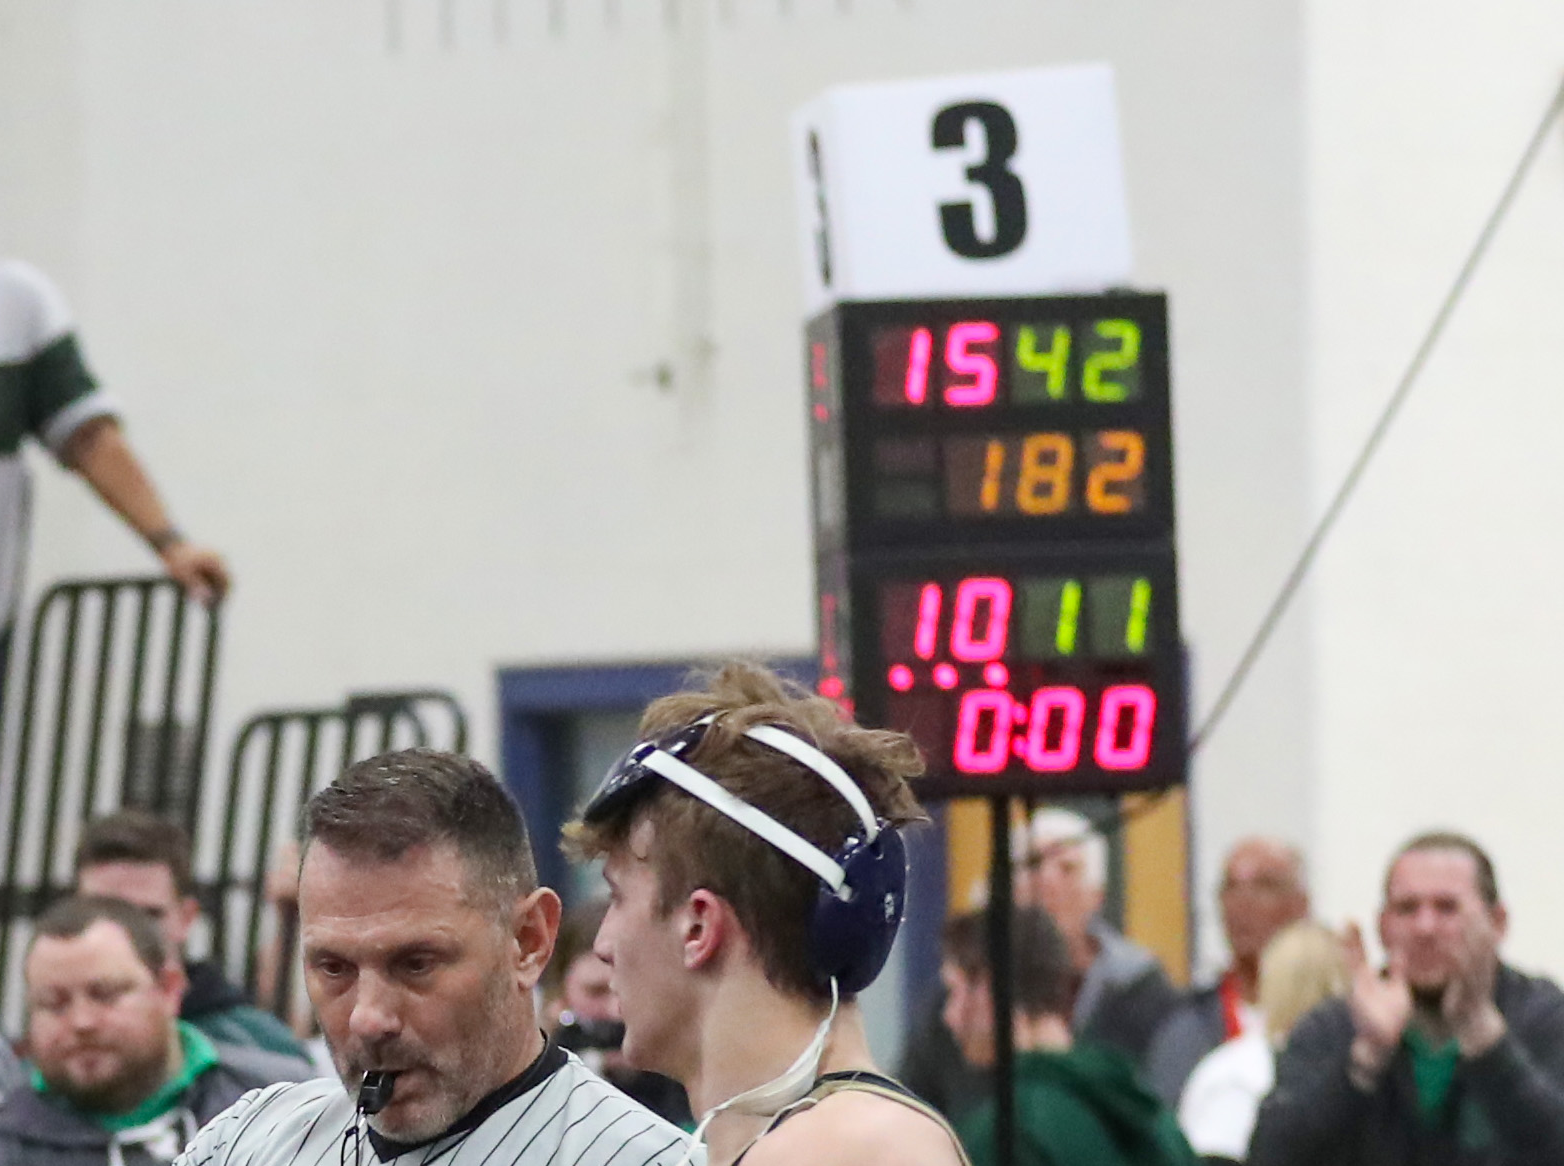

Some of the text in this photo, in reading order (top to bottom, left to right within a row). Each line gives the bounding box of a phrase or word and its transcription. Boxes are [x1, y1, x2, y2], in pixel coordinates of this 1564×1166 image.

[931, 101, 1029, 261] 3
[903, 319, 1140, 408] 15 42
[980, 431, 1145, 515] 182
[913, 576, 1152, 663] 10 11
[954, 685, 1157, 774] 0:00
